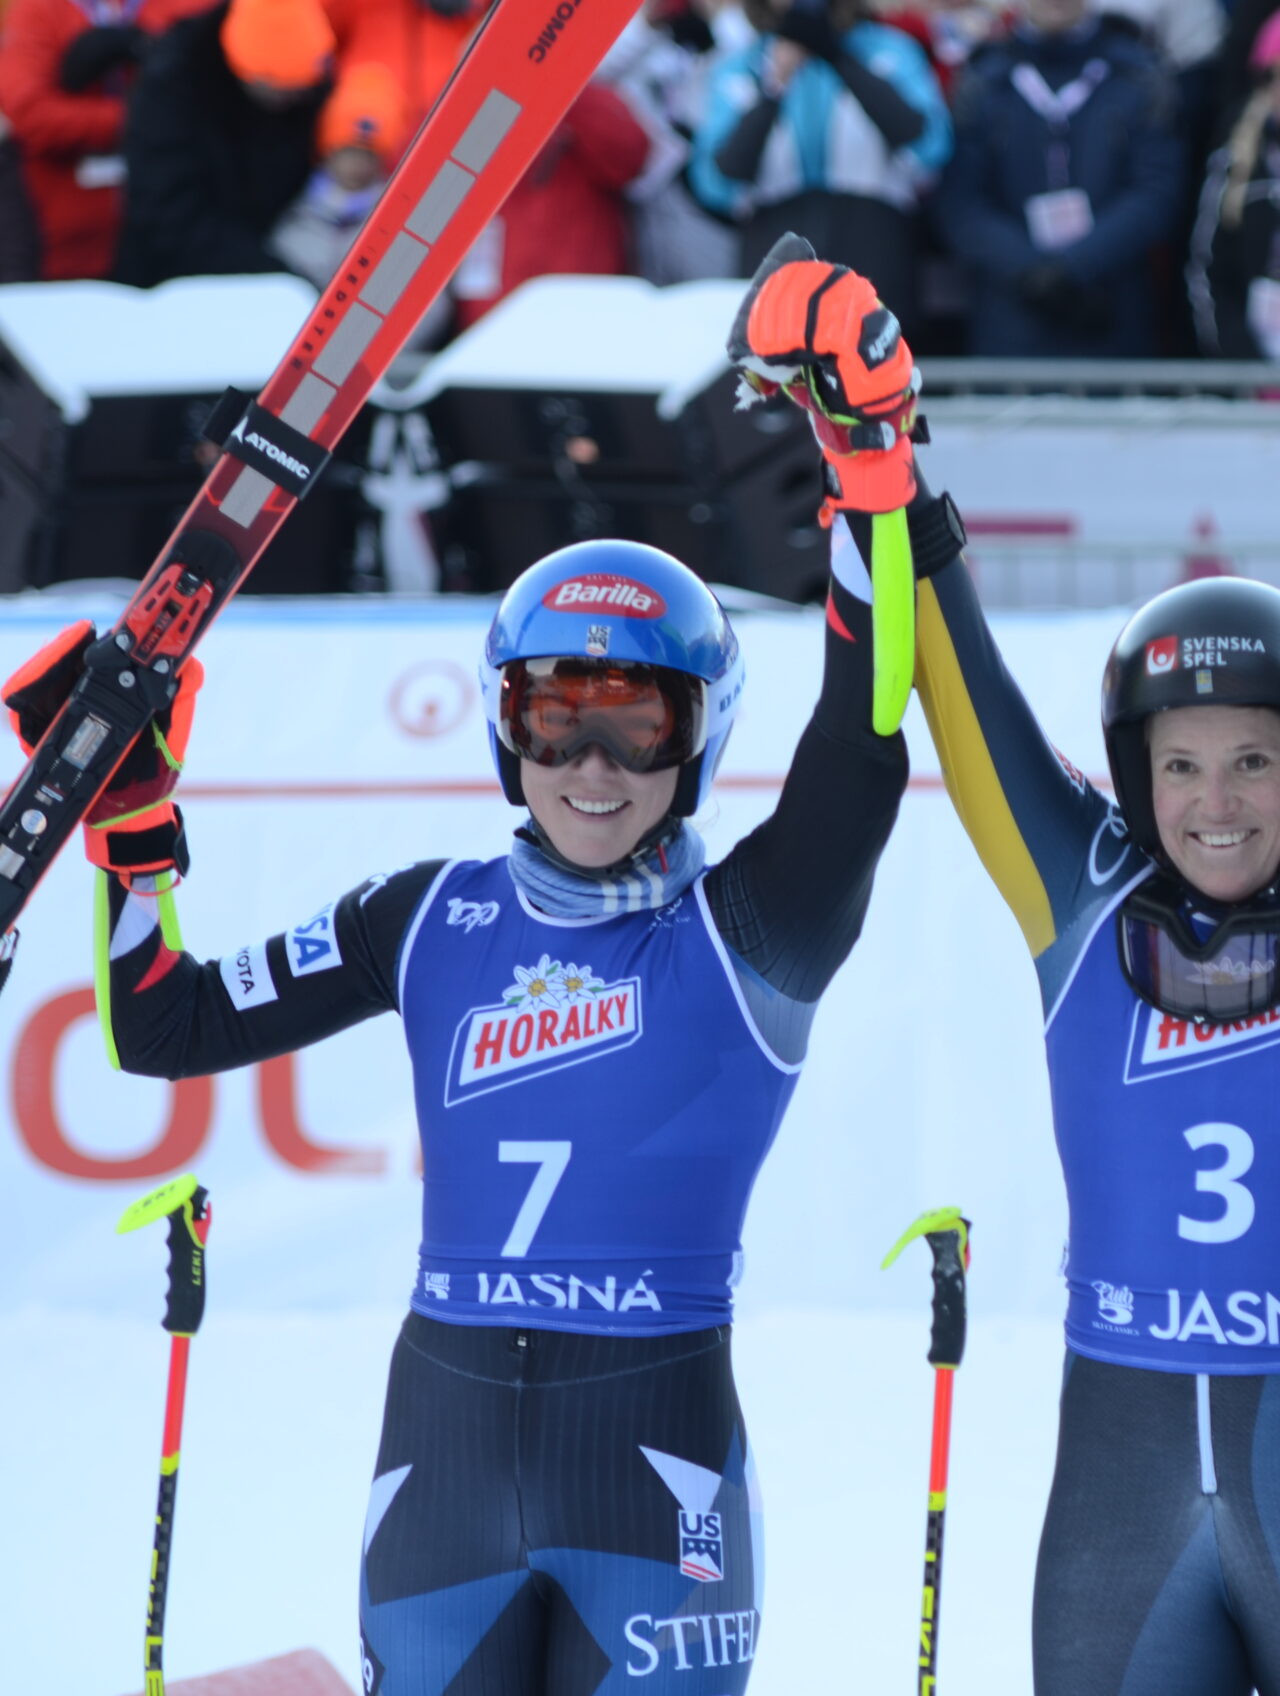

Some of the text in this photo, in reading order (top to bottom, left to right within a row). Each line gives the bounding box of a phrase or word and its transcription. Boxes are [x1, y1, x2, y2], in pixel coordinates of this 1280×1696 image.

[528, 0, 582, 64] OMIC
[244, 431, 311, 480] ATOMIC
[554, 582, 654, 612] Barilla
[1183, 636, 1266, 653] SVENSKA
[1183, 651, 1227, 668] SPEL
[473, 992, 629, 1070] HORALKY
[498, 1140, 572, 1258] 7
[1177, 1122, 1256, 1244] 3
[681, 1512, 720, 1537] US
[623, 1609, 757, 1677] STIFEL
